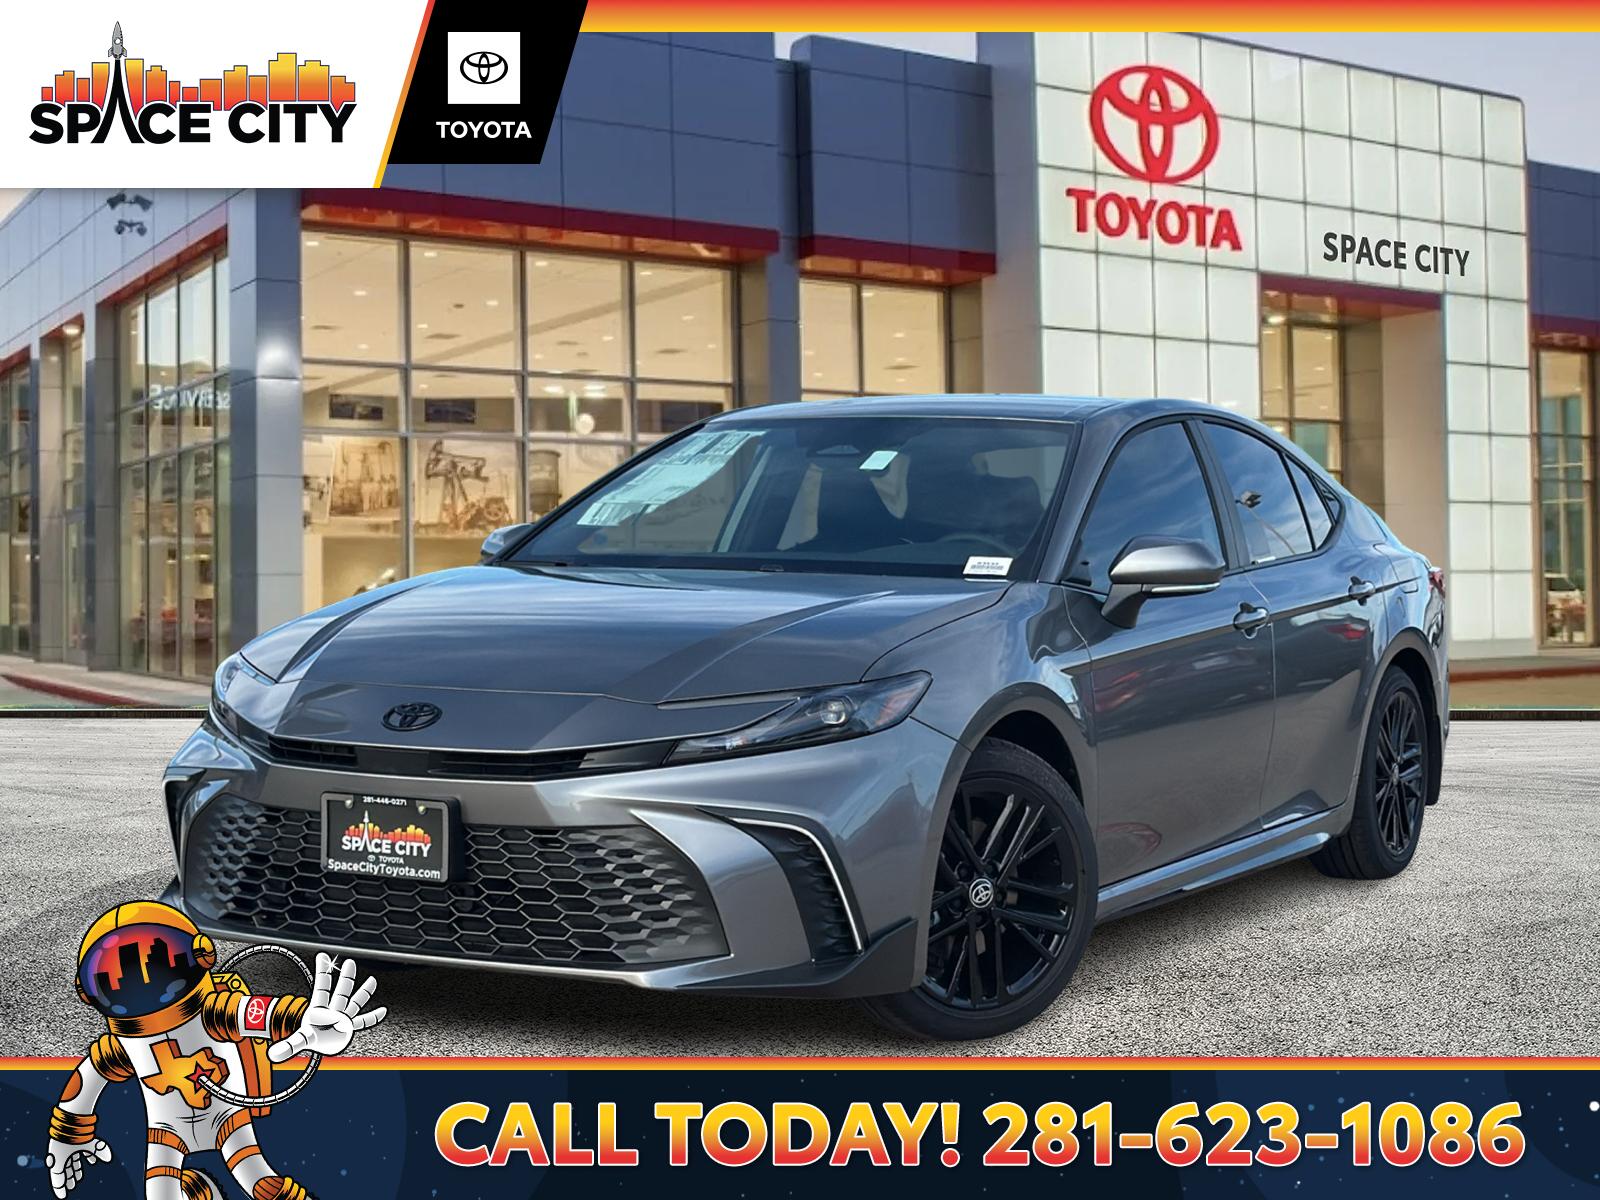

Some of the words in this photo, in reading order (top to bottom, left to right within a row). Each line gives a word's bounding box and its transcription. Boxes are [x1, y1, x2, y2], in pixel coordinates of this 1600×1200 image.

[1066, 188, 1242, 251] TOYOTA
[1323, 232, 1407, 270] SPACE
[1415, 244, 1470, 277] CITY
[378, 855, 404, 864] TOYOTA
[394, 841, 432, 857] CITY
[328, 858, 441, 879] SpaceCityToyota.com
